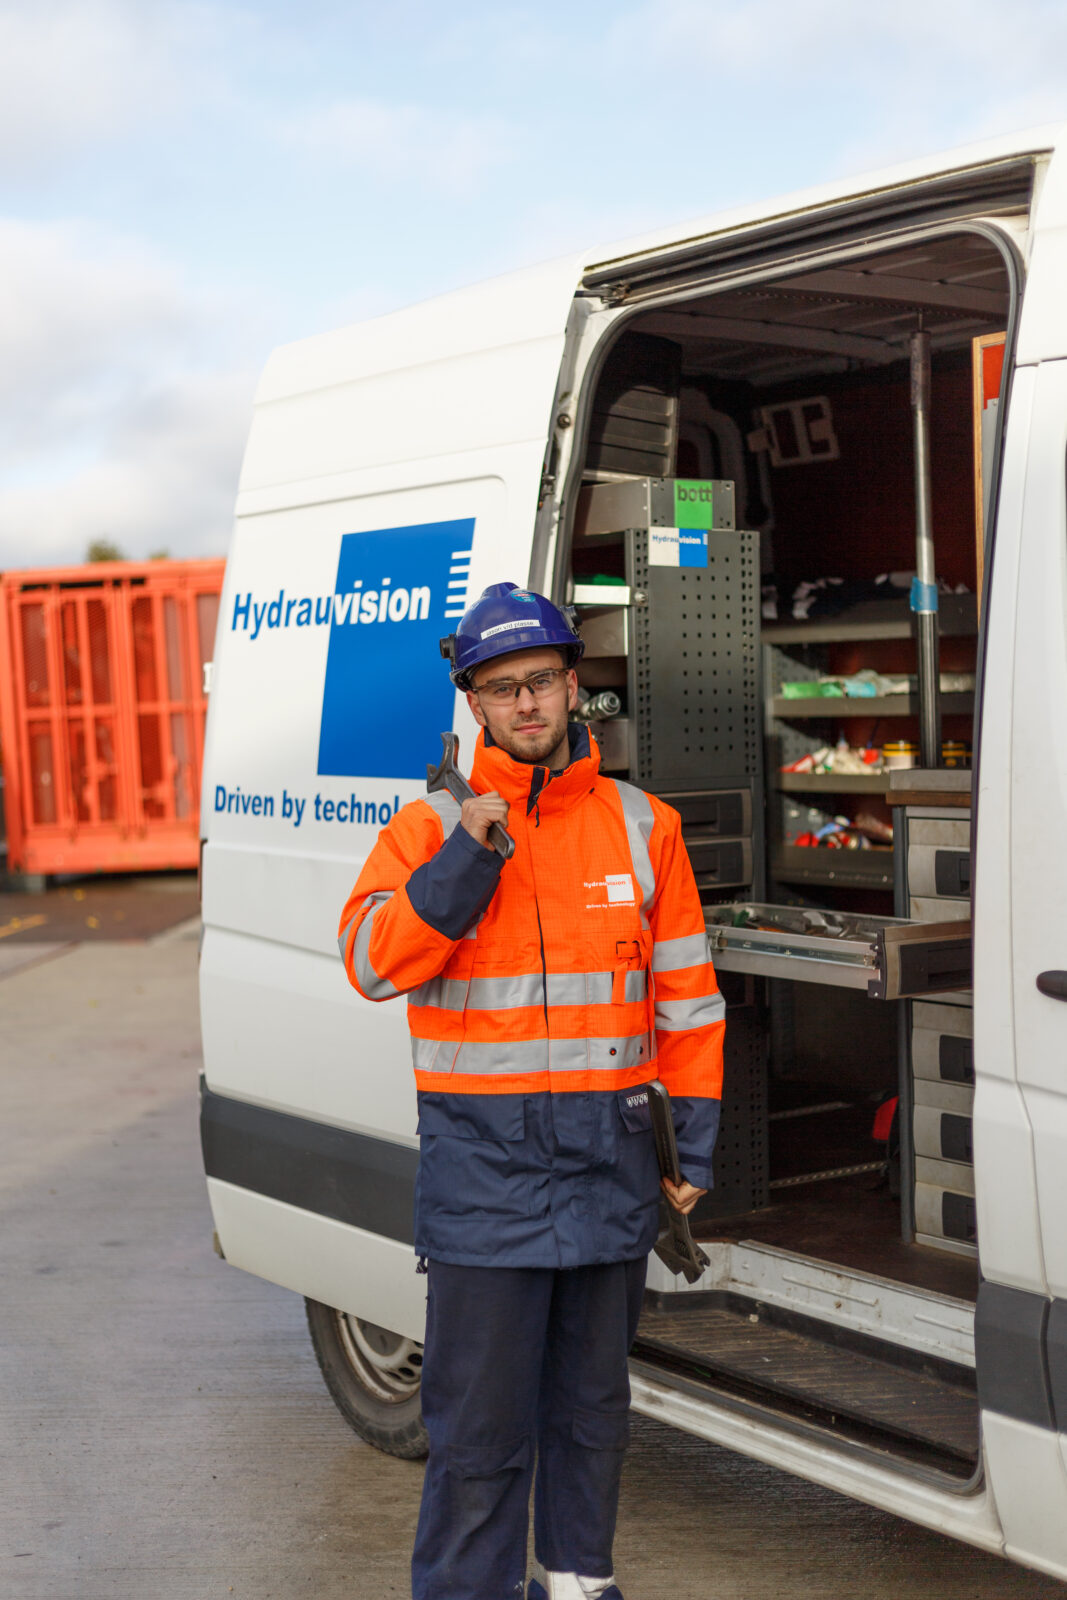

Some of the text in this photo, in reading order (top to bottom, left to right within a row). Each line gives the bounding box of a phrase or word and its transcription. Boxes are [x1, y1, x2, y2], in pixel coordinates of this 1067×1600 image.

[677, 484, 712, 503] bott
[652, 535, 701, 545] Hydrauvision
[231, 577, 431, 640] Hydrauvision
[214, 785, 400, 827] Driven by technol
